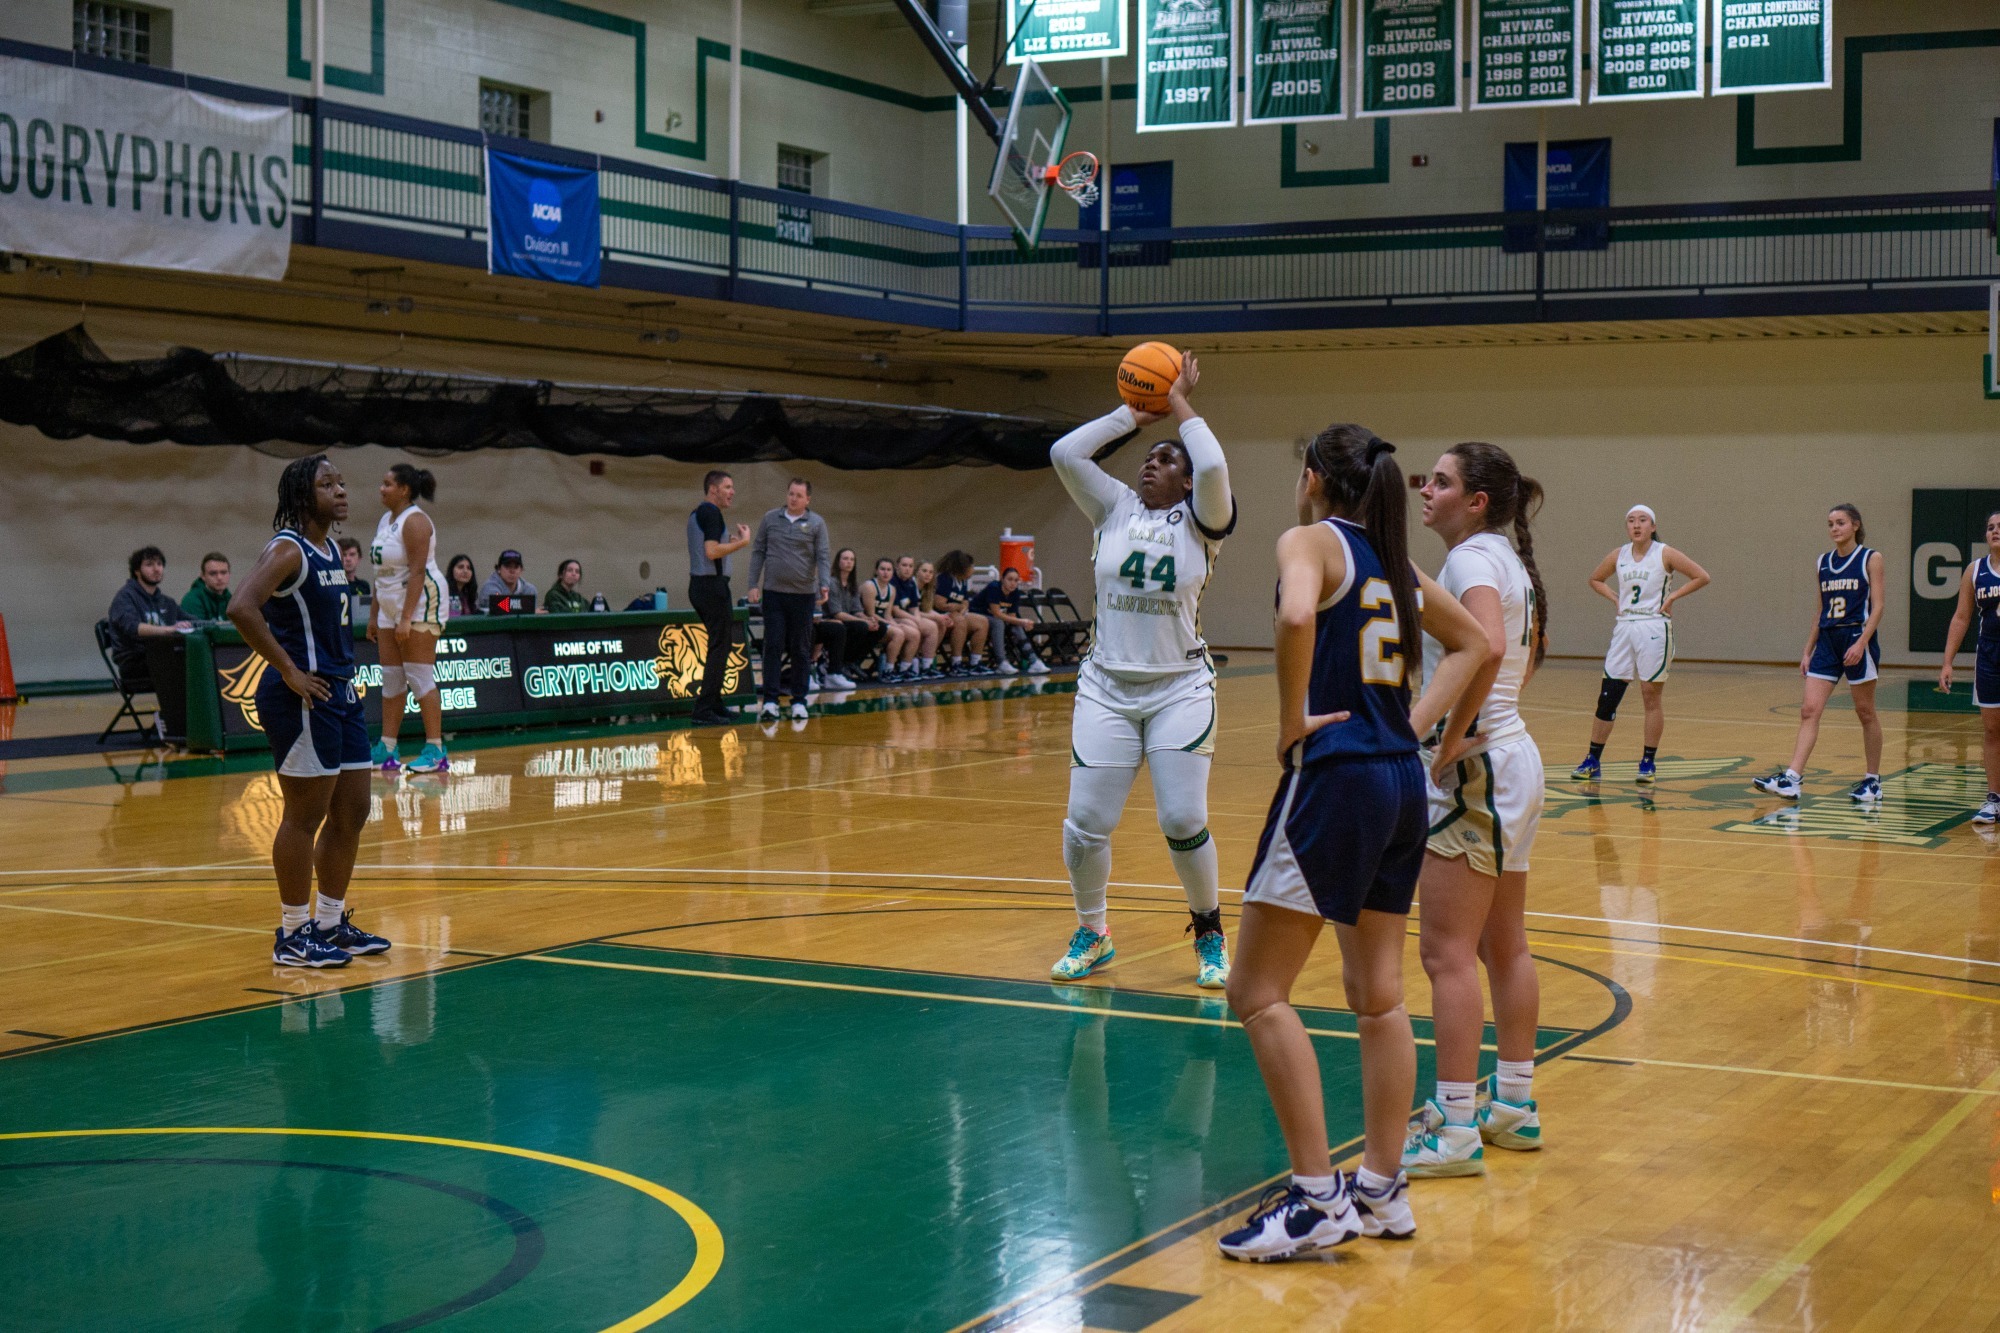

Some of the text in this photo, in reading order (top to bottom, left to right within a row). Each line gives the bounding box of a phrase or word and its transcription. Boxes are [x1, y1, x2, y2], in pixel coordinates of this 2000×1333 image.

[1620, 9, 1676, 25] HVWAC
[1725, 0, 1820, 17] SKYLINE CONFERENCE
[1500, 18, 1554, 33] HVWAC
[1725, 13, 1820, 31] CHAMPIONS
[1384, 27, 1436, 42] HVMAC
[1482, 31, 1571, 48] CHAMPIONS
[1602, 22, 1694, 40] CHAMPIONS
[1023, 37, 1047, 52] LIZ
[1271, 37, 1322, 51] HVWAC
[1367, 39, 1452, 56] CHAMPIONS
[1604, 40, 1691, 58] 1992 2005
[1727, 34, 1770, 49] 2021
[1164, 45, 1214, 60] HVWAC
[1255, 48, 1338, 65] CHAMPIONS
[1485, 49, 1567, 66] 1996 1997
[1148, 57, 1228, 73] CHAMPIONS
[1383, 62, 1436, 80] 2003
[1485, 65, 1567, 82] 1998 2001
[1604, 56, 1690, 74] 2008 2009
[1271, 79, 1322, 97] 2005
[1485, 81, 1567, 98] 2010 2012
[1628, 75, 1666, 89] 2010
[1165, 87, 1212, 104] 1997
[1383, 83, 1436, 101] 2006
[532, 203, 562, 223] NCAA
[524, 235, 560, 255] Division
[1119, 367, 1155, 392] Wilson
[1119, 550, 1177, 592] 44
[1827, 578, 1859, 591] JOSEPH'S
[1631, 585, 1642, 605] 3
[340, 592, 349, 626] 2
[1107, 593, 1183, 617] LAWRENCE
[1826, 596, 1846, 619] 12
[449, 638, 468, 653] TO
[554, 639, 623, 656] HOME OF THE
[524, 660, 659, 698] GRYPHONS
